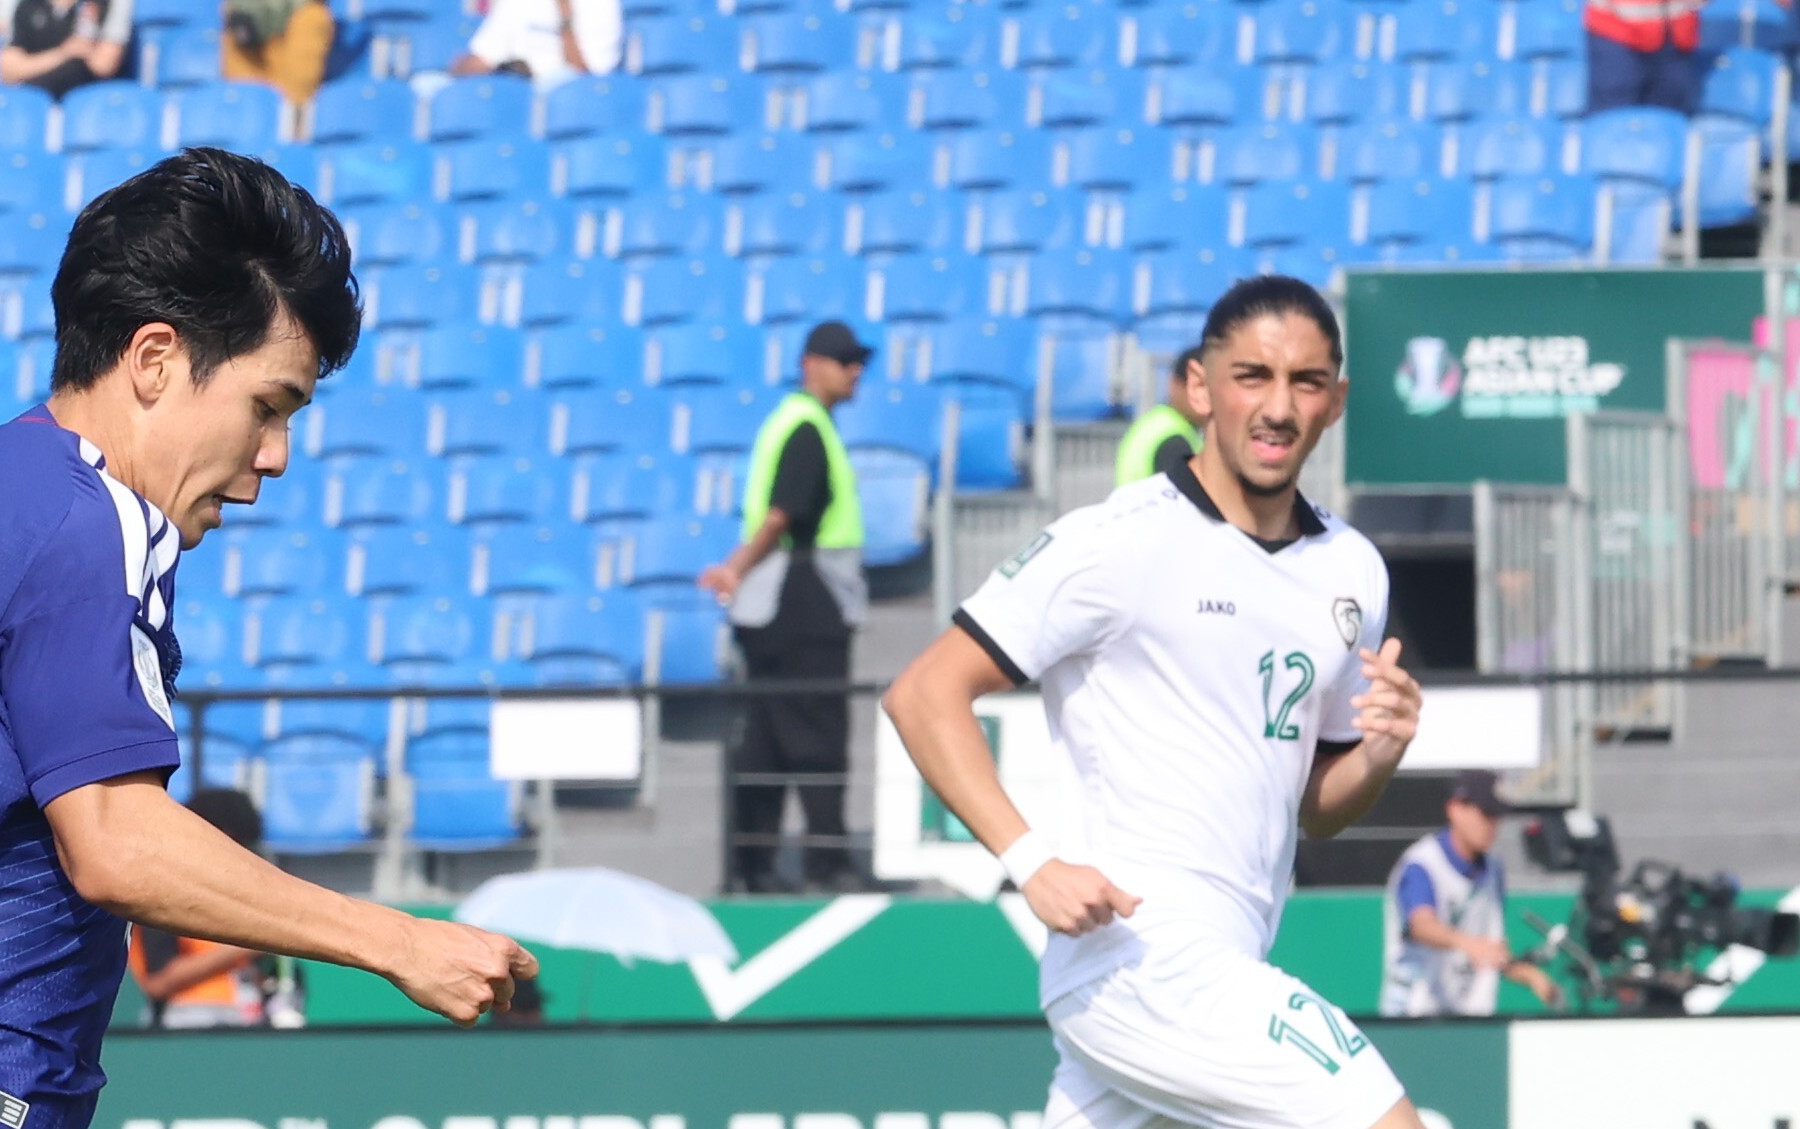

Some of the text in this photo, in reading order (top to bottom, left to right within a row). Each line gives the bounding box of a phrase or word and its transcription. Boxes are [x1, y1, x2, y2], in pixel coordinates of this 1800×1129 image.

[1197, 600, 1236, 616] JAKO
[1258, 647, 1316, 740] 12
[1268, 992, 1368, 1075] 12
